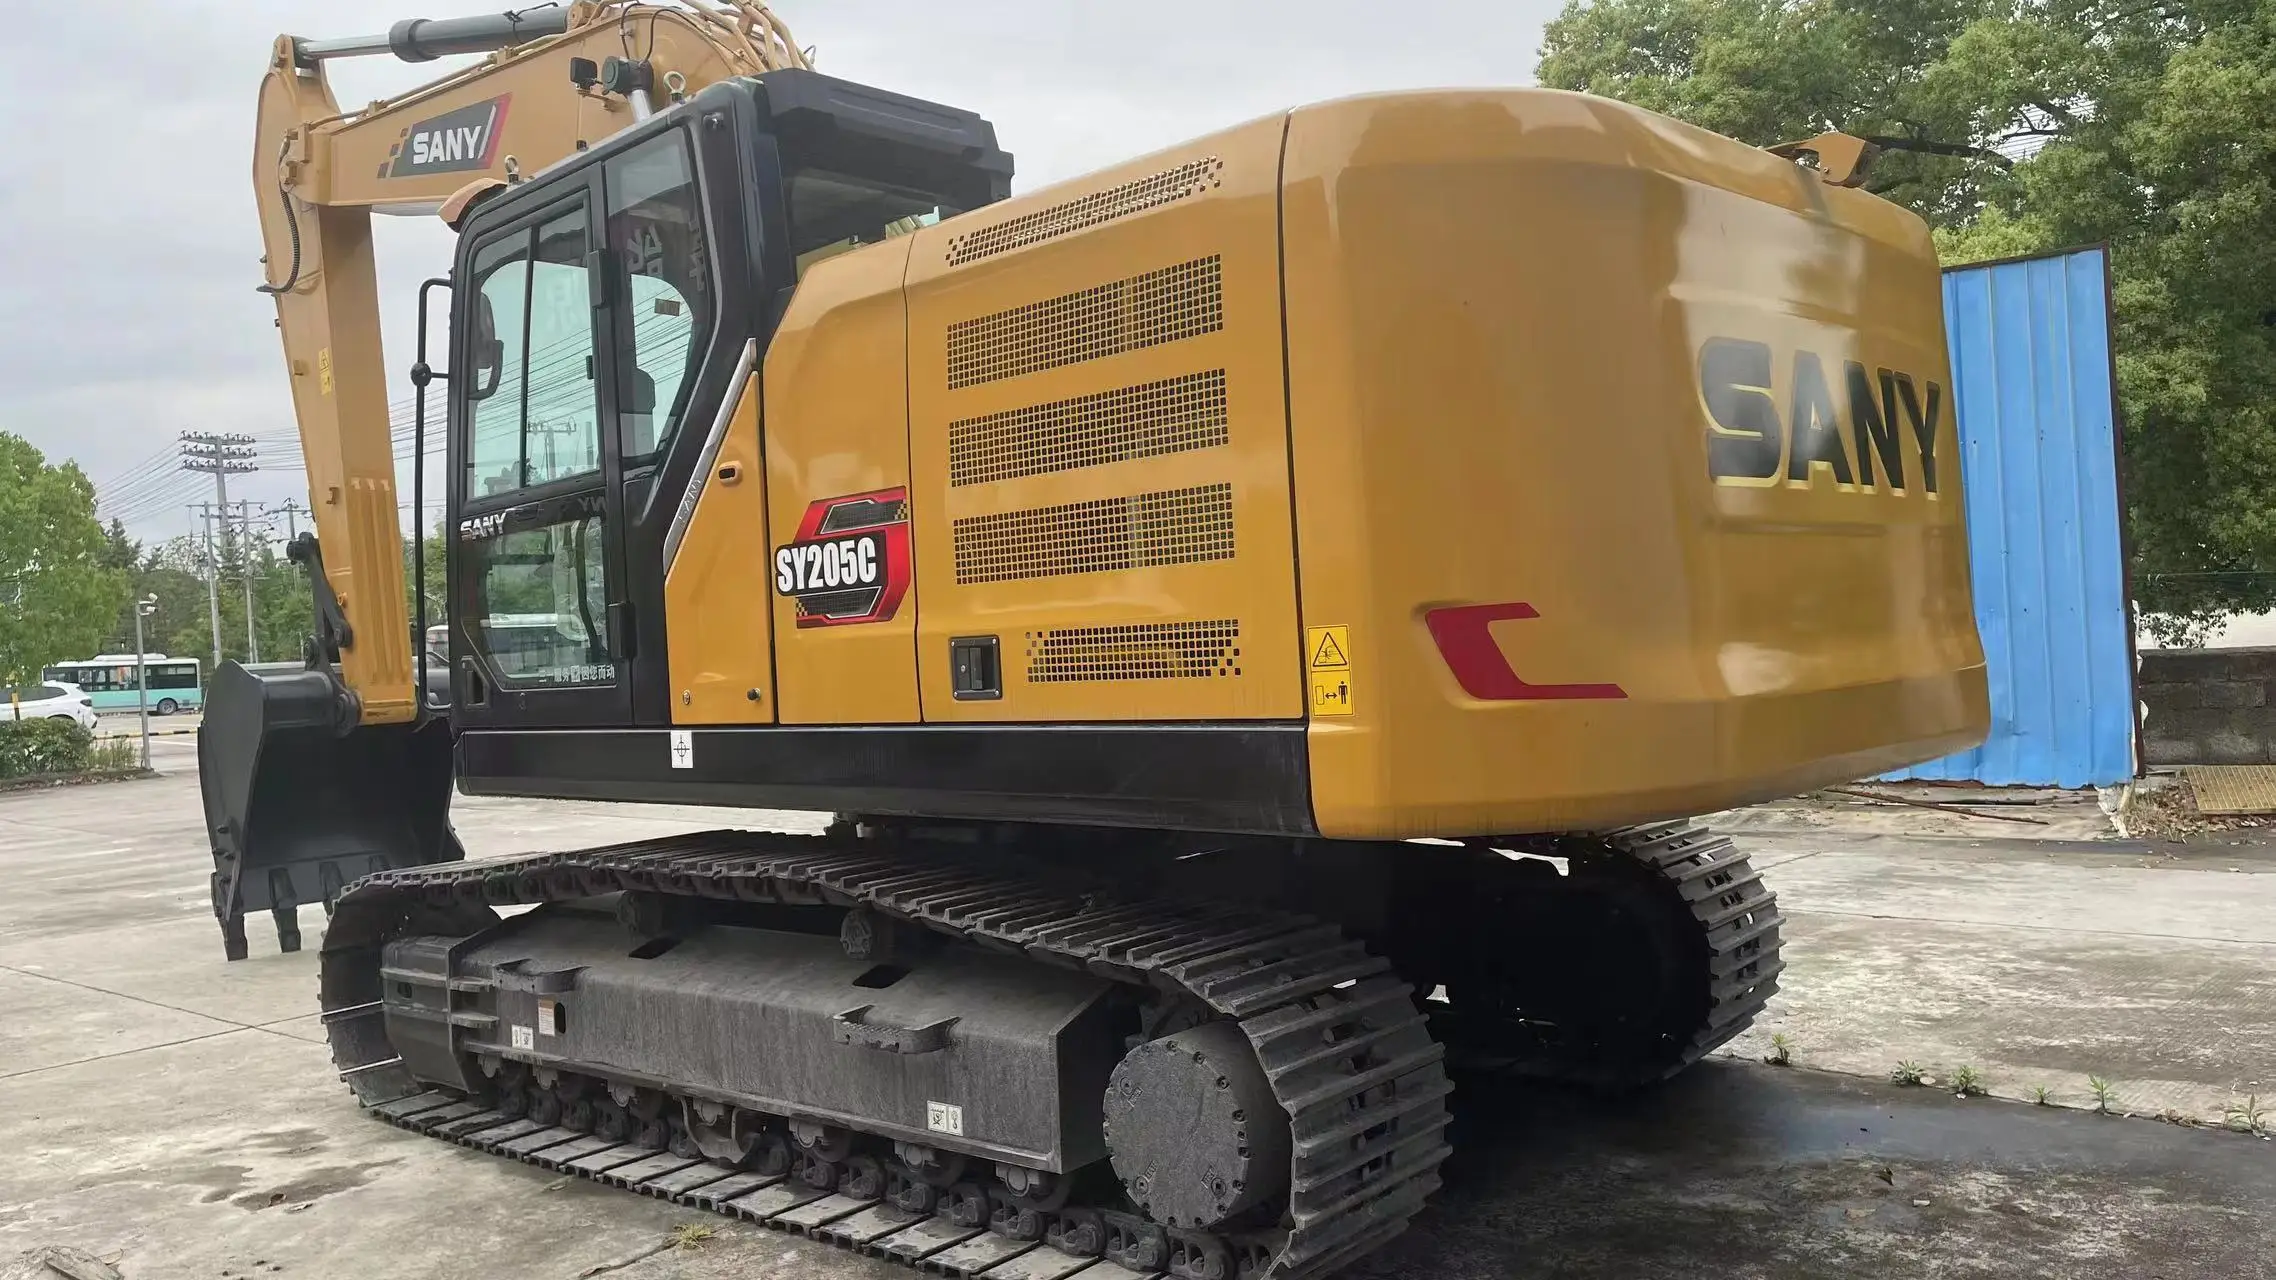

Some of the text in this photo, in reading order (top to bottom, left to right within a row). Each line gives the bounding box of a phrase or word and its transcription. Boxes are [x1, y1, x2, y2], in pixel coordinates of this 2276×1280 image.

[413, 125, 482, 165] SANY
[1698, 337, 1941, 501] SANY
[460, 512, 507, 542] SANY
[776, 537, 877, 593] SY205C
